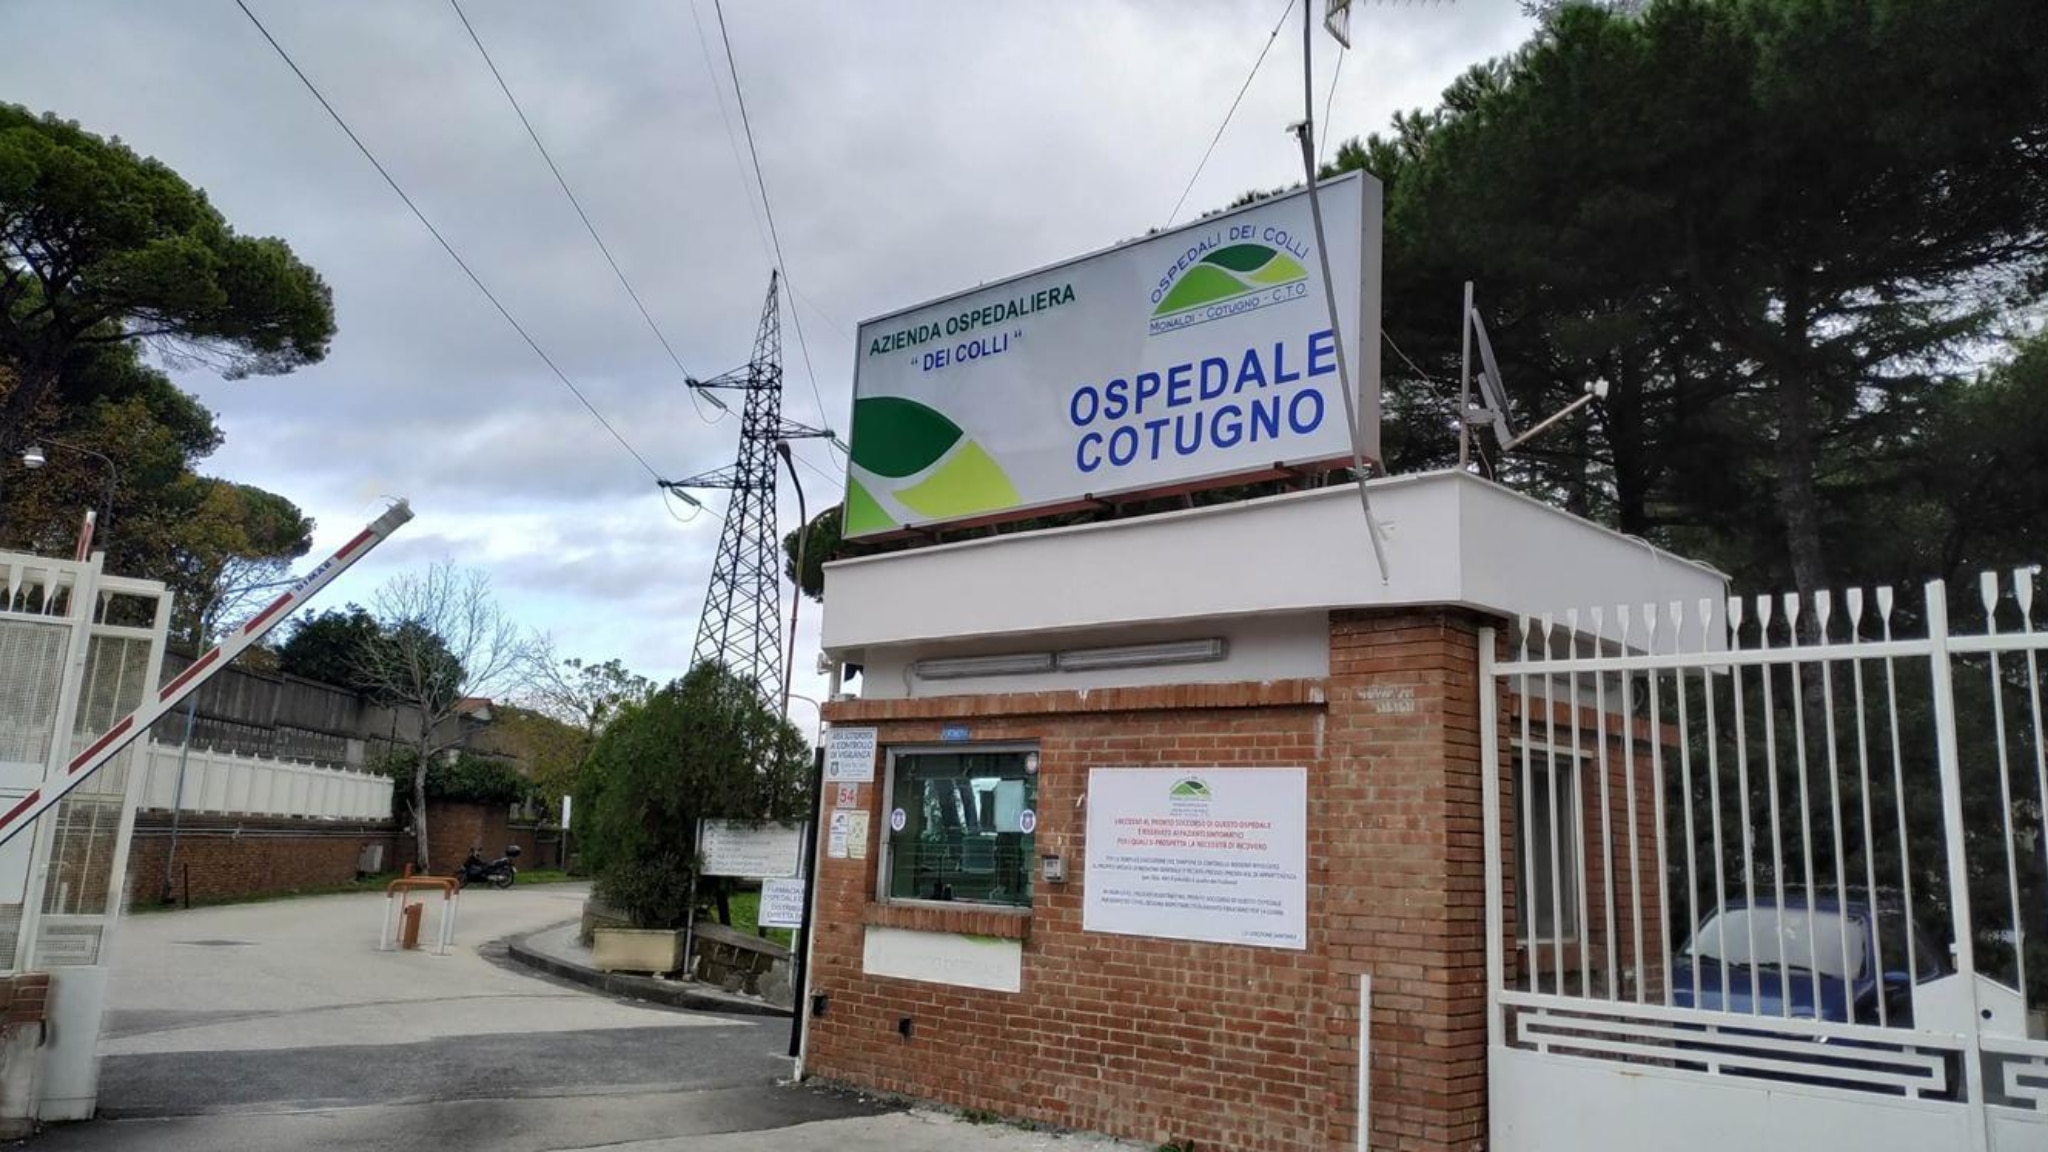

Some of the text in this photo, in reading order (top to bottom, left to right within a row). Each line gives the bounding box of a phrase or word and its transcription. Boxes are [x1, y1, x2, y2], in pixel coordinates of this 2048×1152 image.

[1151, 225, 1309, 304] OSPEDALI DEI COLLI
[869, 283, 1076, 356] AZIENDA OSPEDALIERA
[1150, 314, 1195, 332] MONALDI
[1206, 297, 1260, 318] COTUGNO
[923, 348, 950, 372] DEI
[955, 332, 1008, 363] COLLI
[1070, 329, 1336, 427] OSPEDALE
[1076, 388, 1325, 473] COTUGNO
[837, 741, 873, 750] CONTROLLO
[840, 788, 855, 803] 54
